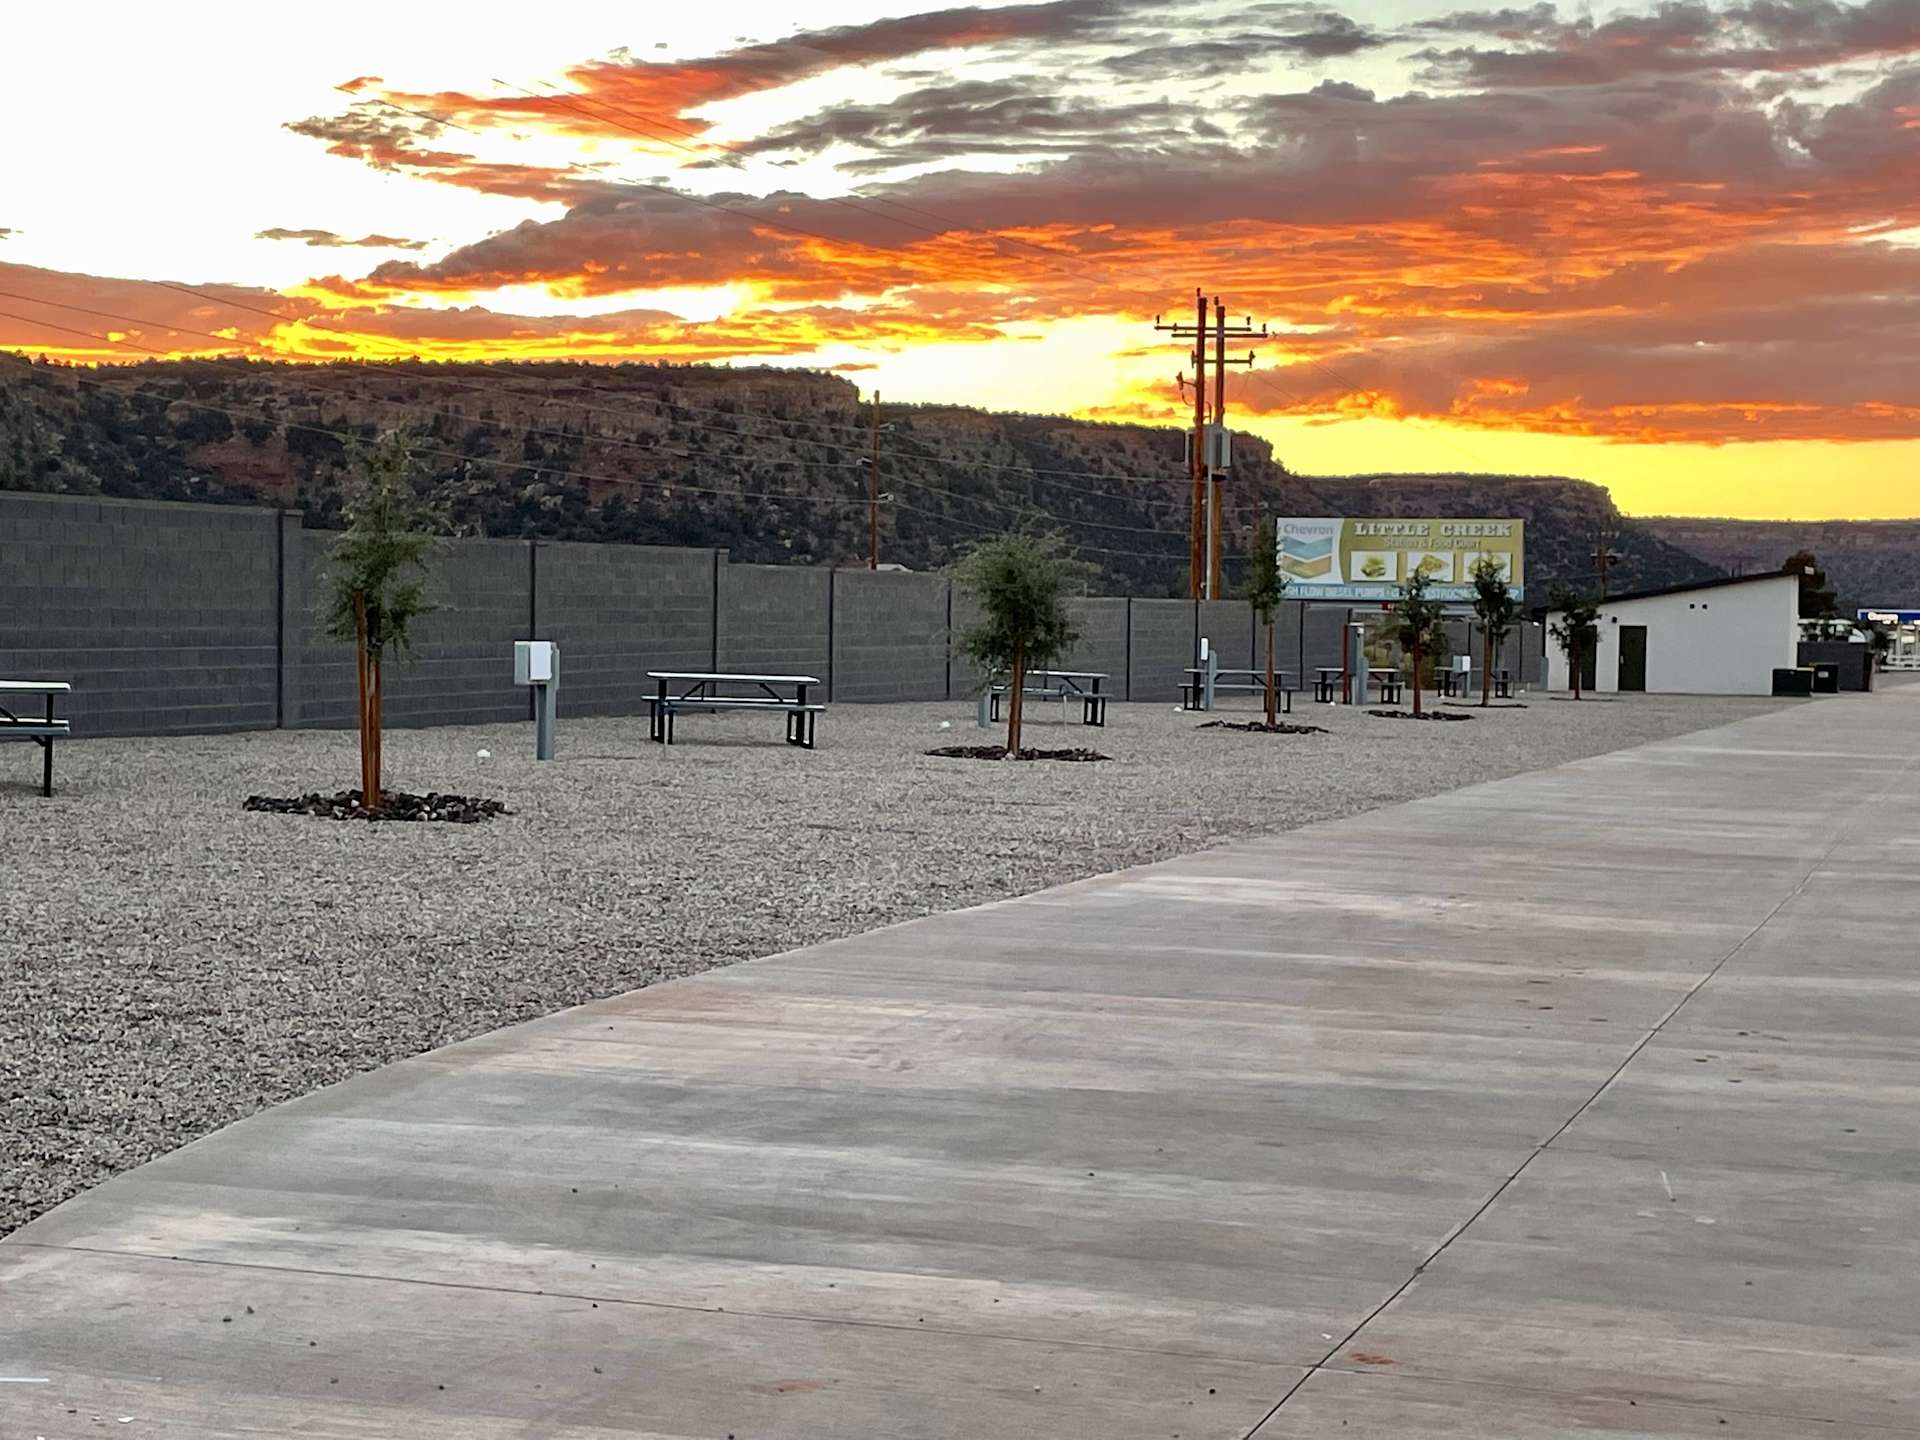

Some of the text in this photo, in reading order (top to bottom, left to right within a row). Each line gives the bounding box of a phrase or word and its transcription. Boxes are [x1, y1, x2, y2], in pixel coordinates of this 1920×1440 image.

[1283, 523, 1333, 536] Chevron
[1354, 522, 1512, 536] LITTLE CREEK
